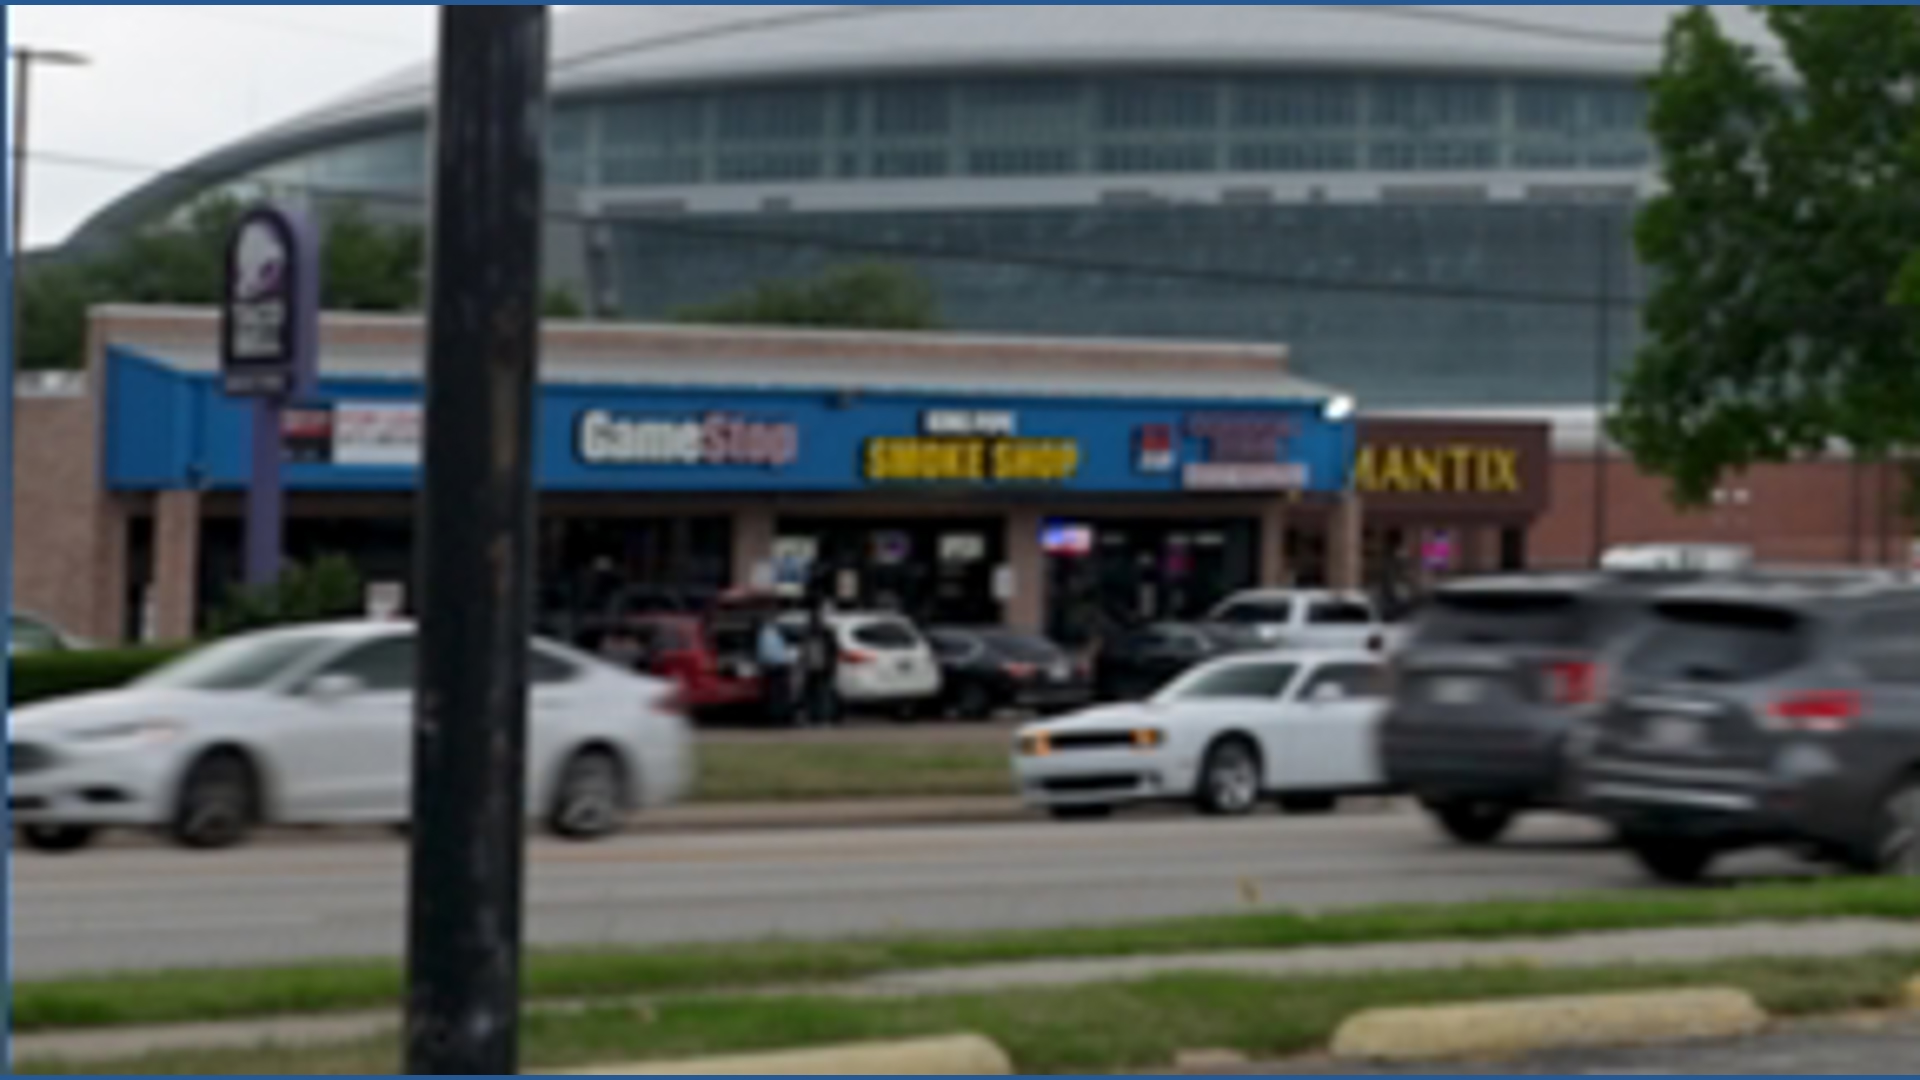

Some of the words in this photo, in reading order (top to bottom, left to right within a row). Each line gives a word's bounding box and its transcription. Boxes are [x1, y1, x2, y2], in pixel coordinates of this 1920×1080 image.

[580, 410, 799, 466] GameStop
[865, 437, 984, 480] SMOKE
[993, 438, 1079, 480] SHOP
